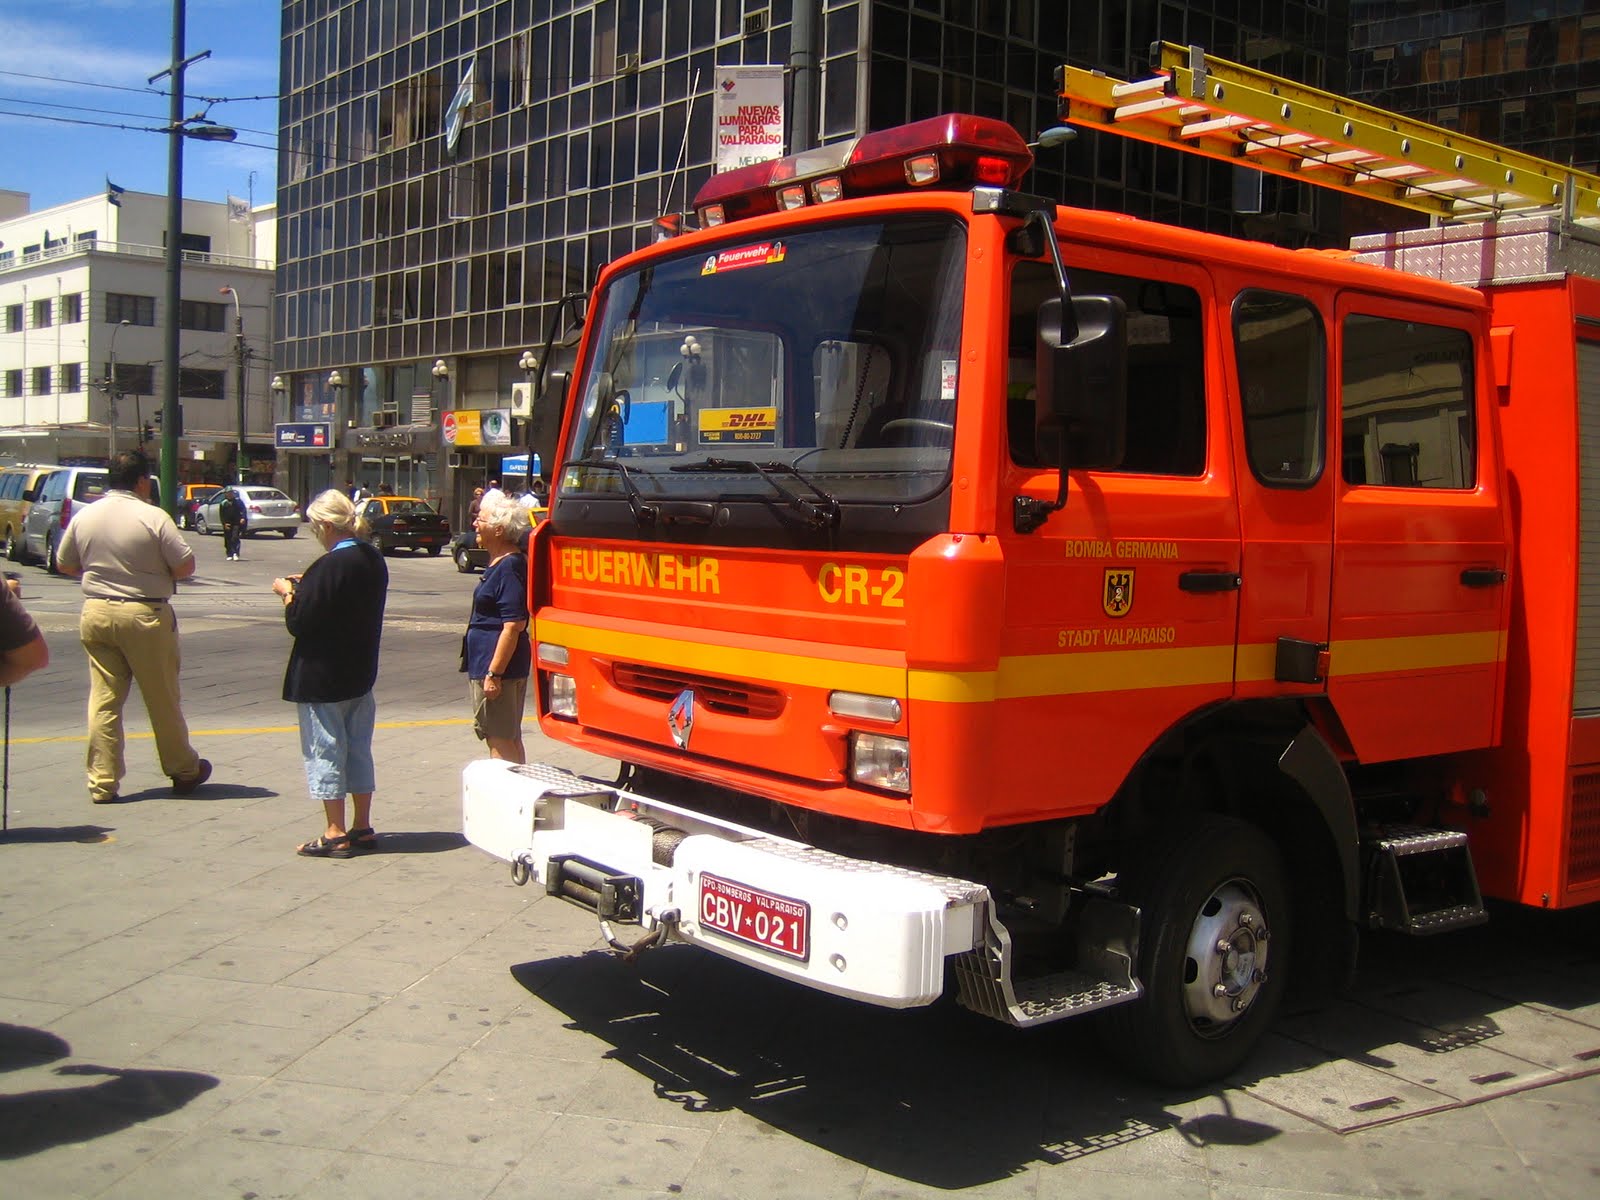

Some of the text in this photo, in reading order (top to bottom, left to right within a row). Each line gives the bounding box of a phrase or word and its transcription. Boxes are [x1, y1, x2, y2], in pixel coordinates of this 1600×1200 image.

[738, 106, 780, 116] NUEVAS
[719, 116, 781, 126] LUMINARIAS
[720, 133, 782, 145] VALPARAÍSO
[738, 126, 765, 135] PARA
[718, 246, 769, 263] Feuerwehr
[729, 413, 768, 427] DHL
[1065, 540, 1179, 559] BOMBA GERMANIA
[561, 547, 720, 594] FEUERWEHR
[818, 562, 905, 608] CR-2
[1058, 626, 1176, 648] STADT VALPARAISO
[756, 895, 803, 918] VALPARAISO
